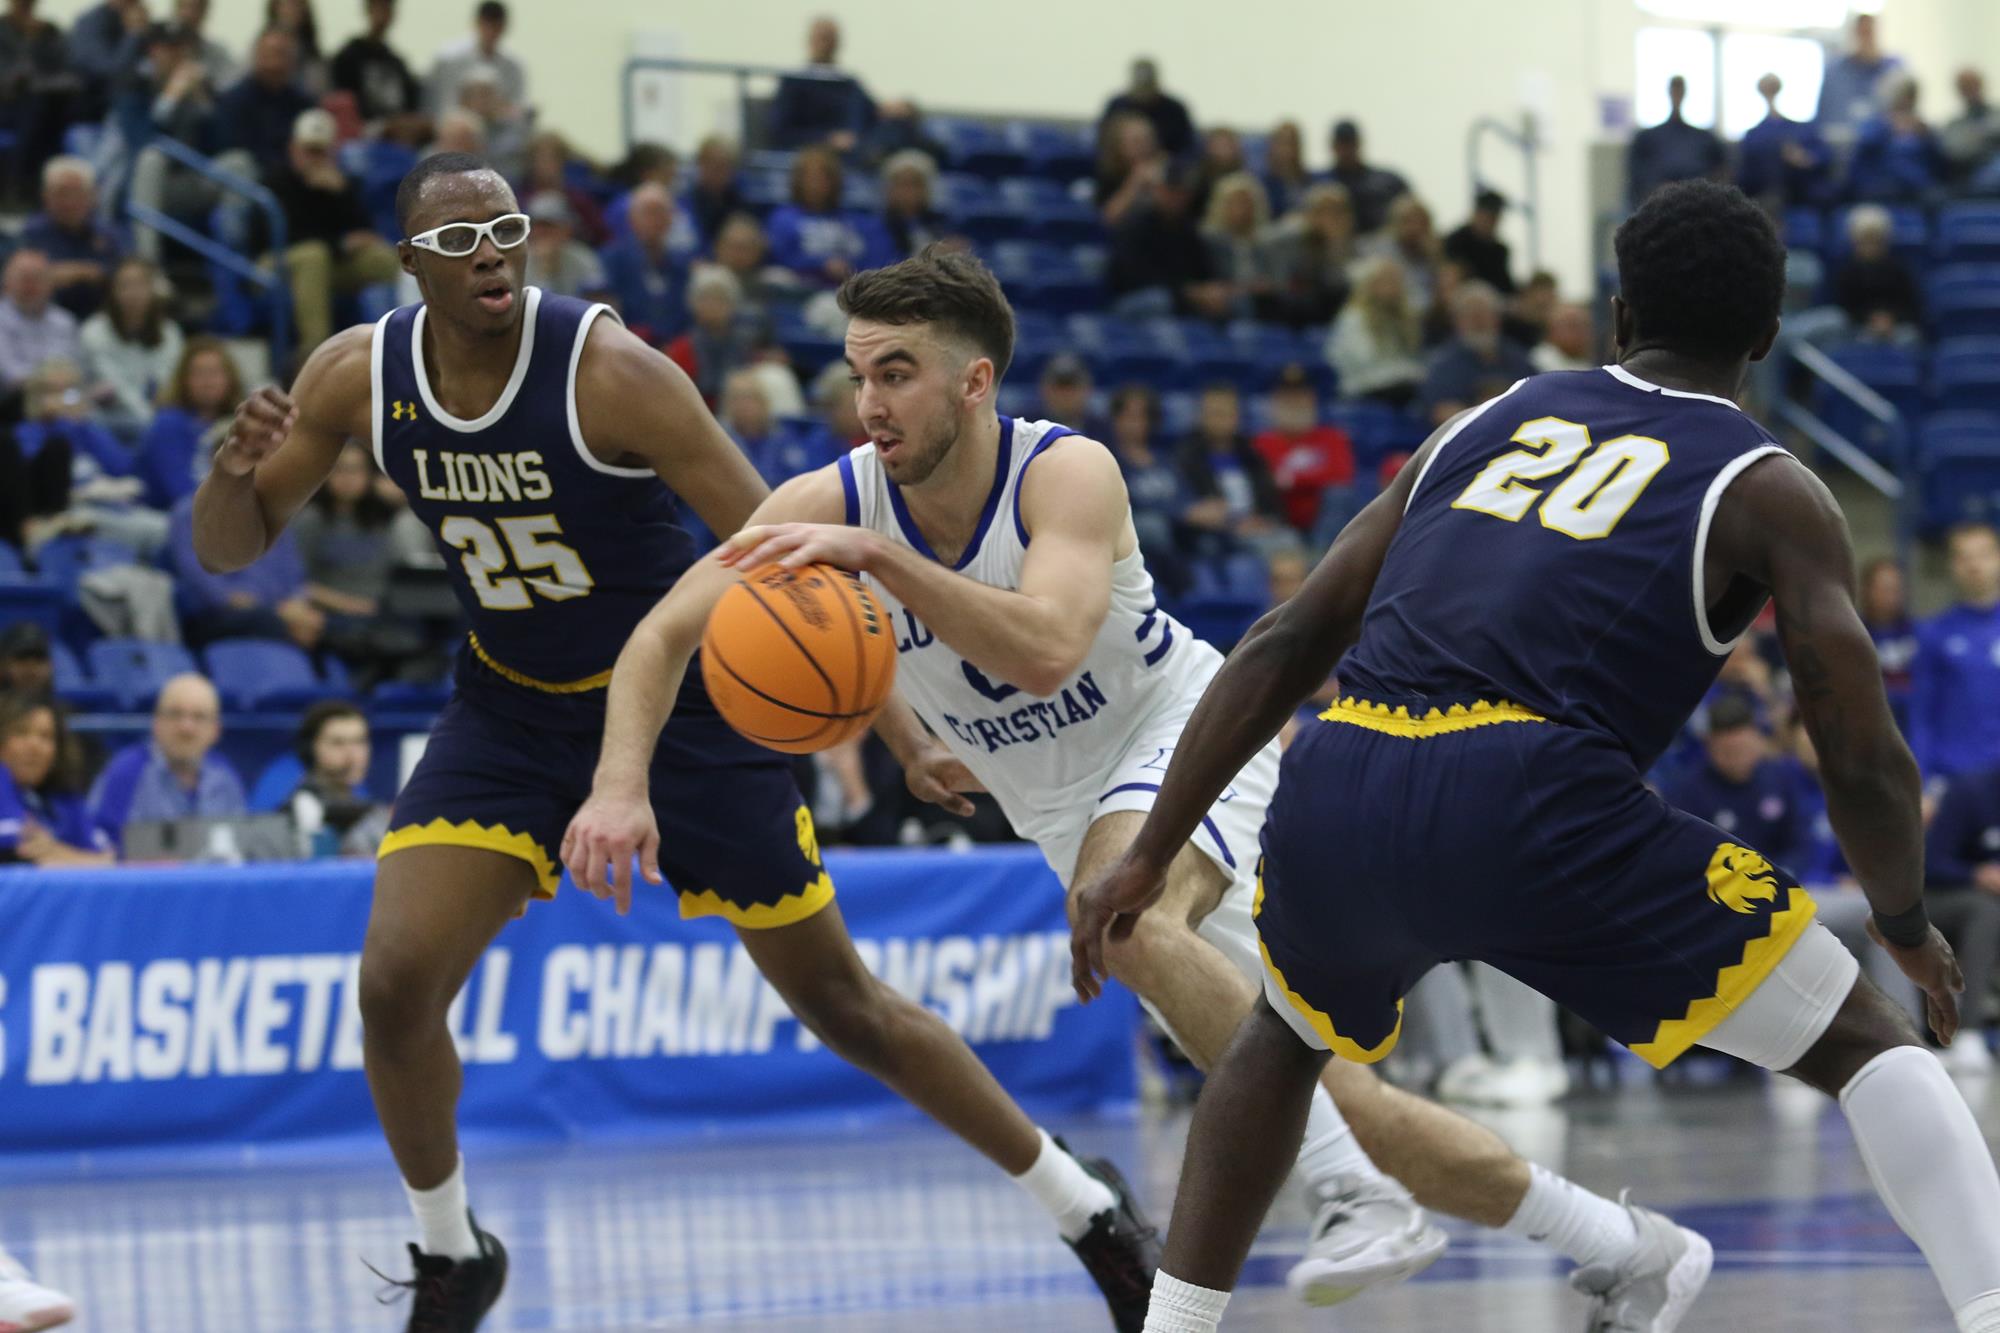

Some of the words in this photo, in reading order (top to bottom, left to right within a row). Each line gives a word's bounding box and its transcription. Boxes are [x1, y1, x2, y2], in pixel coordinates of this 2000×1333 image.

[413, 448, 553, 502] LIONS
[1450, 416, 1670, 540] 20
[440, 513, 595, 611] 25
